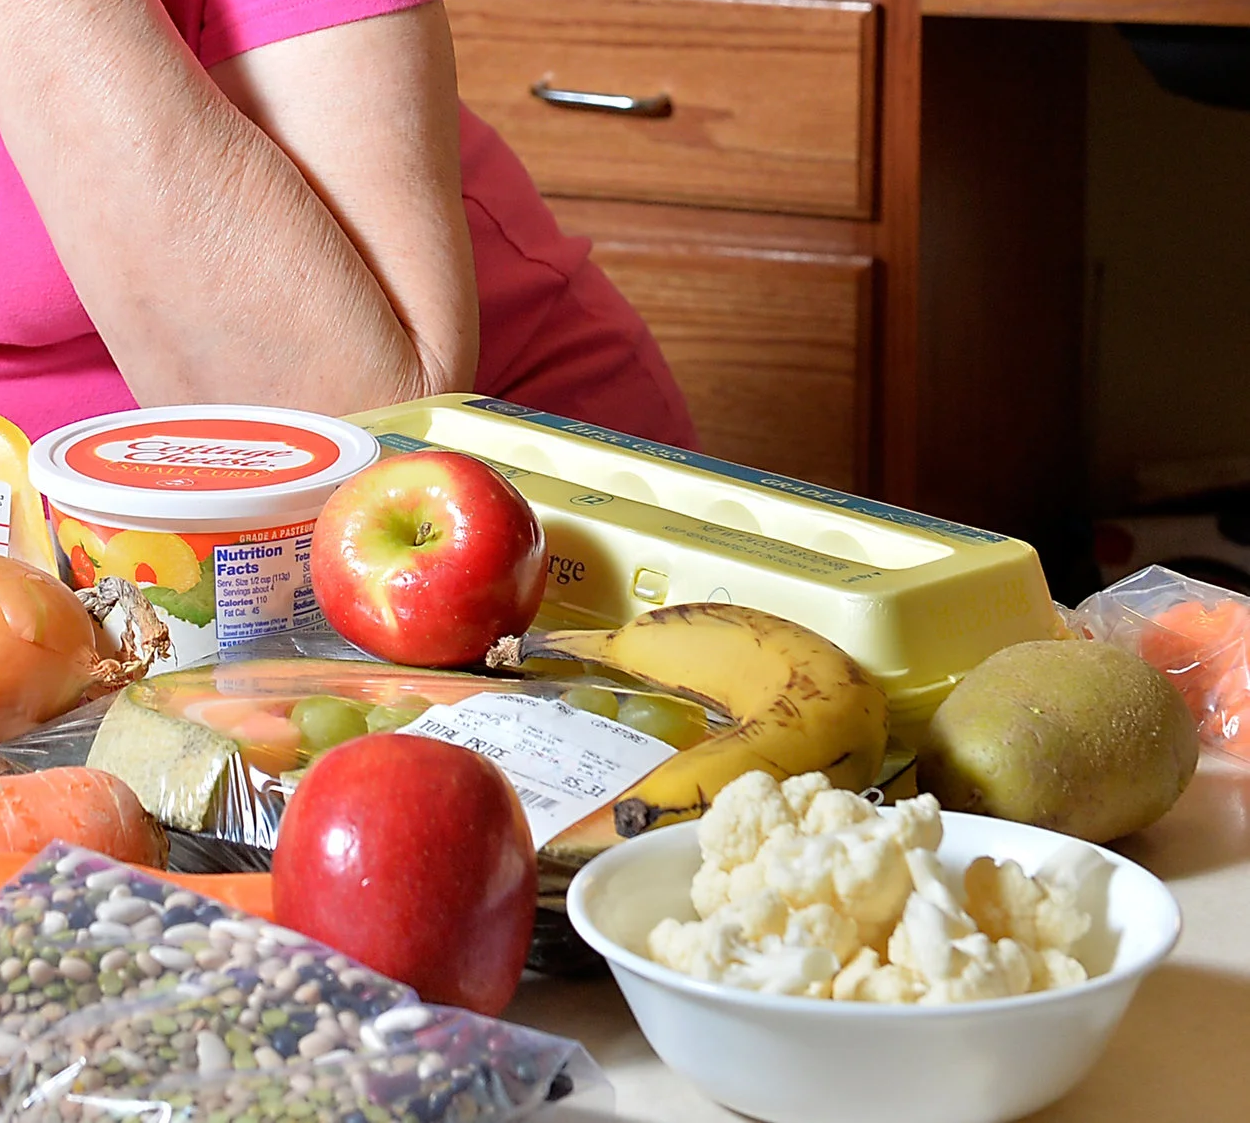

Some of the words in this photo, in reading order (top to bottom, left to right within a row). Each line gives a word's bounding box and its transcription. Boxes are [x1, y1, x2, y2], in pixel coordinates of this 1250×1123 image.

[127, 441, 293, 458] Cottage
[124, 451, 268, 467] Cheese
[119, 463, 189, 476] SMALL
[193, 468, 261, 478] CURD
[578, 494, 604, 505] 12
[240, 531, 269, 543] GRADE
[272, 531, 277, 539] A
[217, 546, 282, 562] Nutrition
[217, 562, 259, 576] Facts
[547, 555, 586, 585] rge
[218, 579, 234, 587] Serv.
[236, 578, 248, 586] Size
[272, 572, 291, 583] (113g)
[223, 588, 250, 597] Servings
[252, 585, 269, 594] about
[218, 599, 253, 607] Calories
[256, 595, 267, 603] 110
[224, 609, 234, 617] Fat
[252, 607, 260, 615] 45
[419, 719, 459, 748] TOTAL
[463, 737, 511, 760] PRICE
